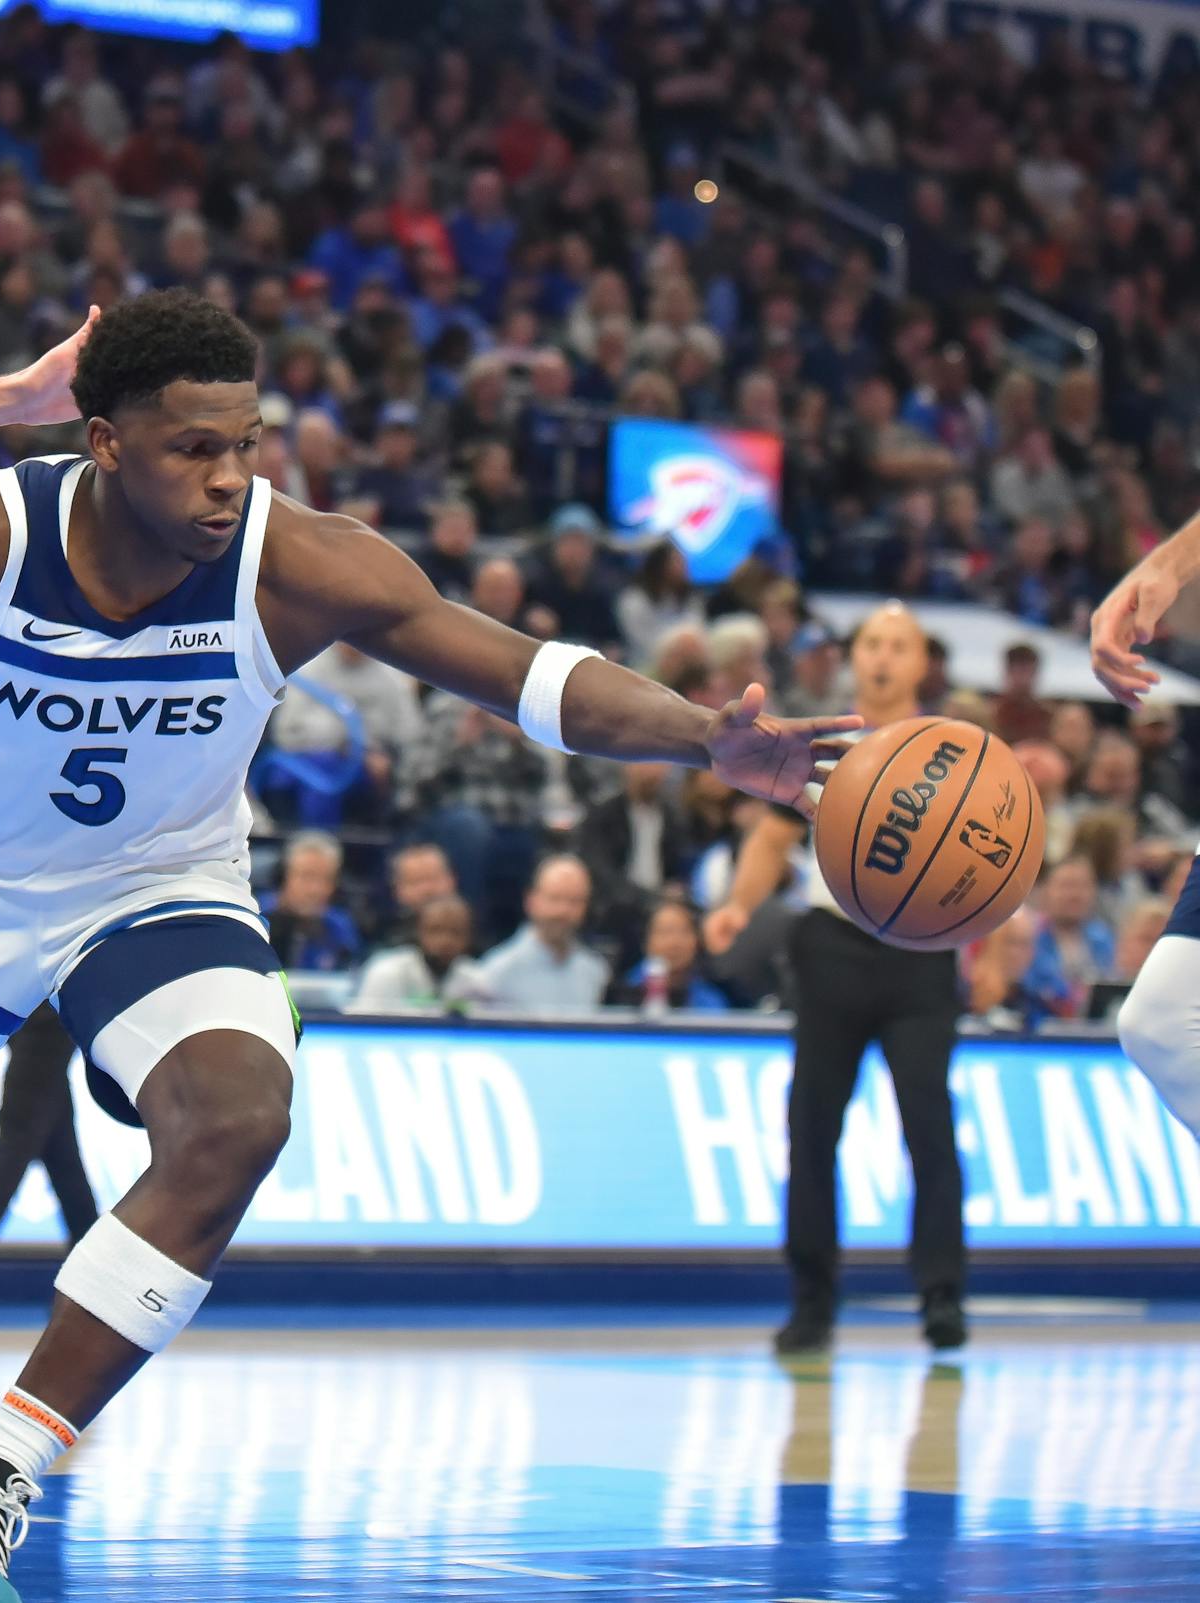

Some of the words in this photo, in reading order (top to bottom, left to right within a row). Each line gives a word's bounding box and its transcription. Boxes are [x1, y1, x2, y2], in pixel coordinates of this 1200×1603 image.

[49, 747, 128, 827] 5
[864, 741, 967, 876] Wilson
[136, 1288, 169, 1313] 5
